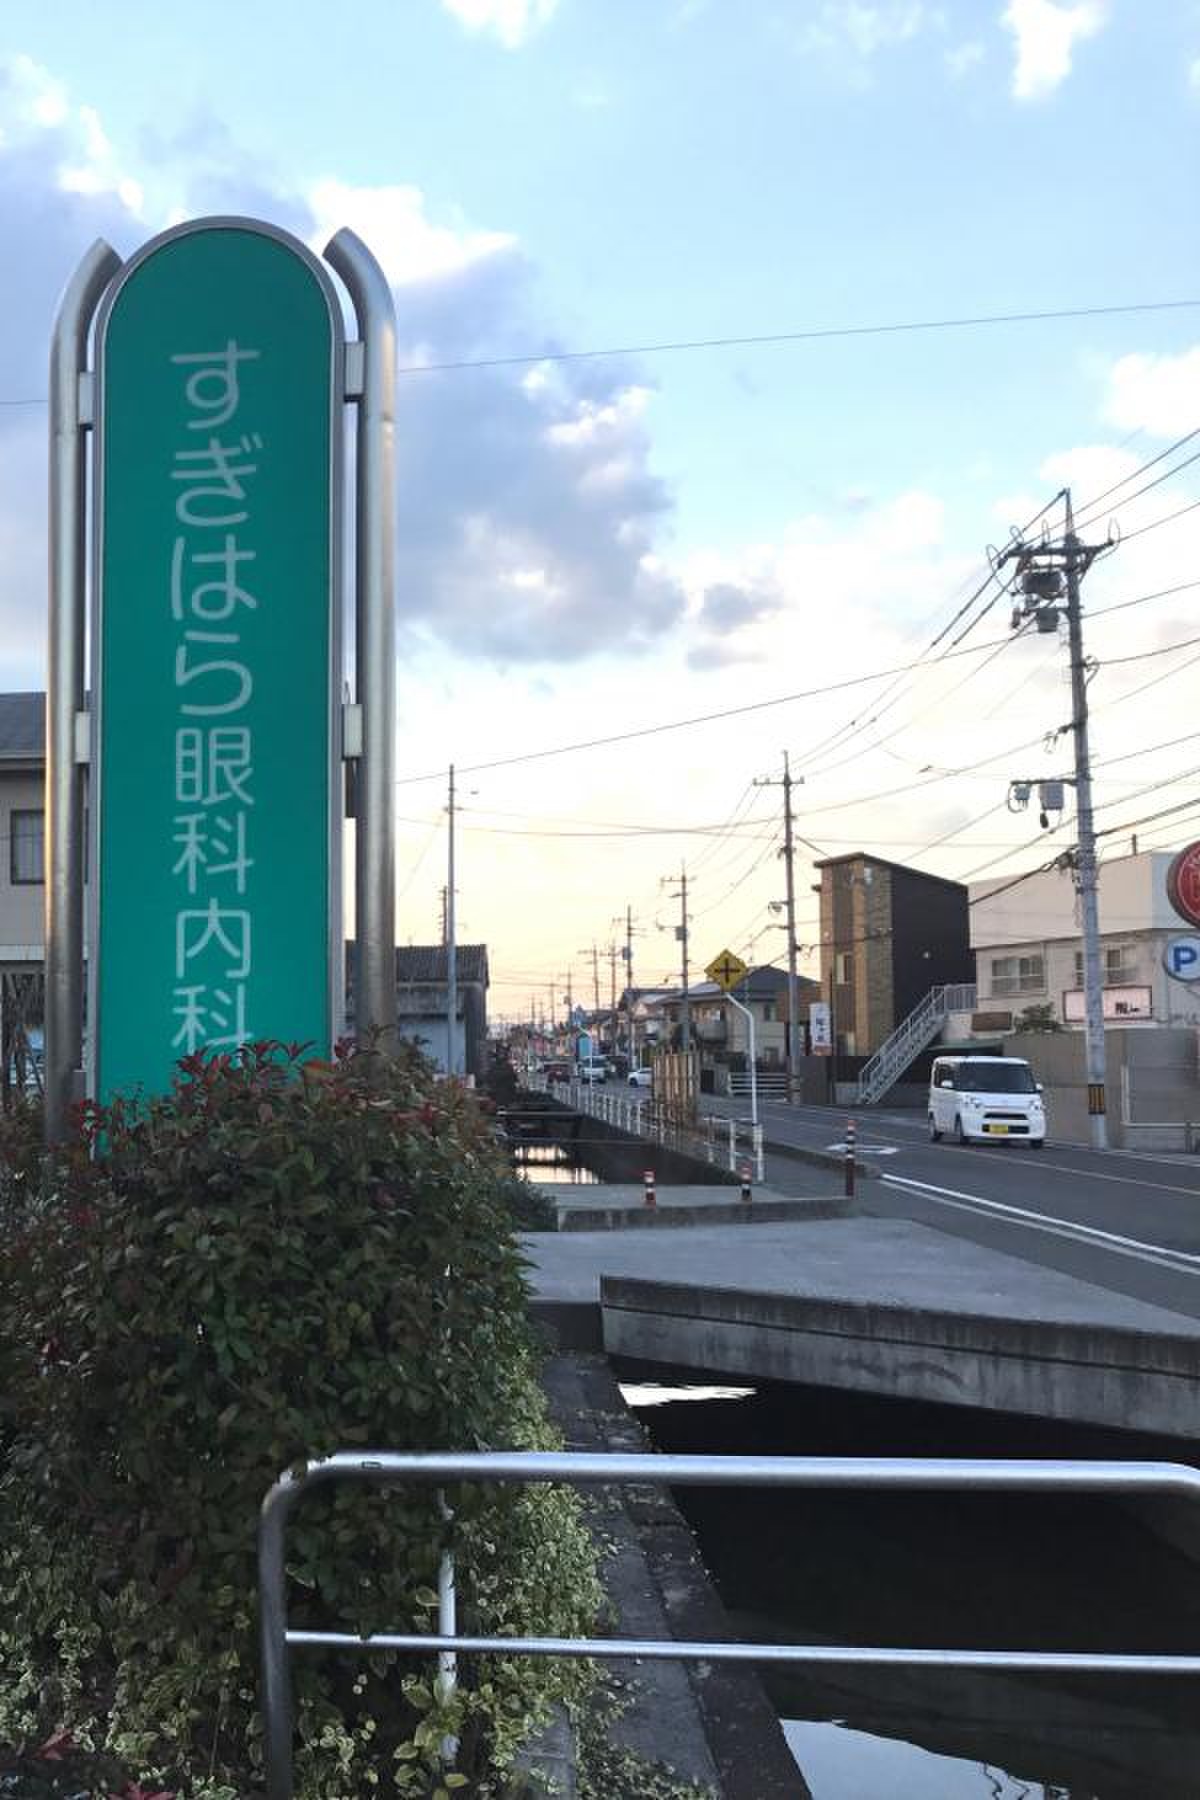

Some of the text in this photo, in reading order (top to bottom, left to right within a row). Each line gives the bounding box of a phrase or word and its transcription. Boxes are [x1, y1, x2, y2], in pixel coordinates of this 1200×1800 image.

[170, 339, 262, 1064] すぎはら眼科内科
[1174, 947, 1197, 971] P
